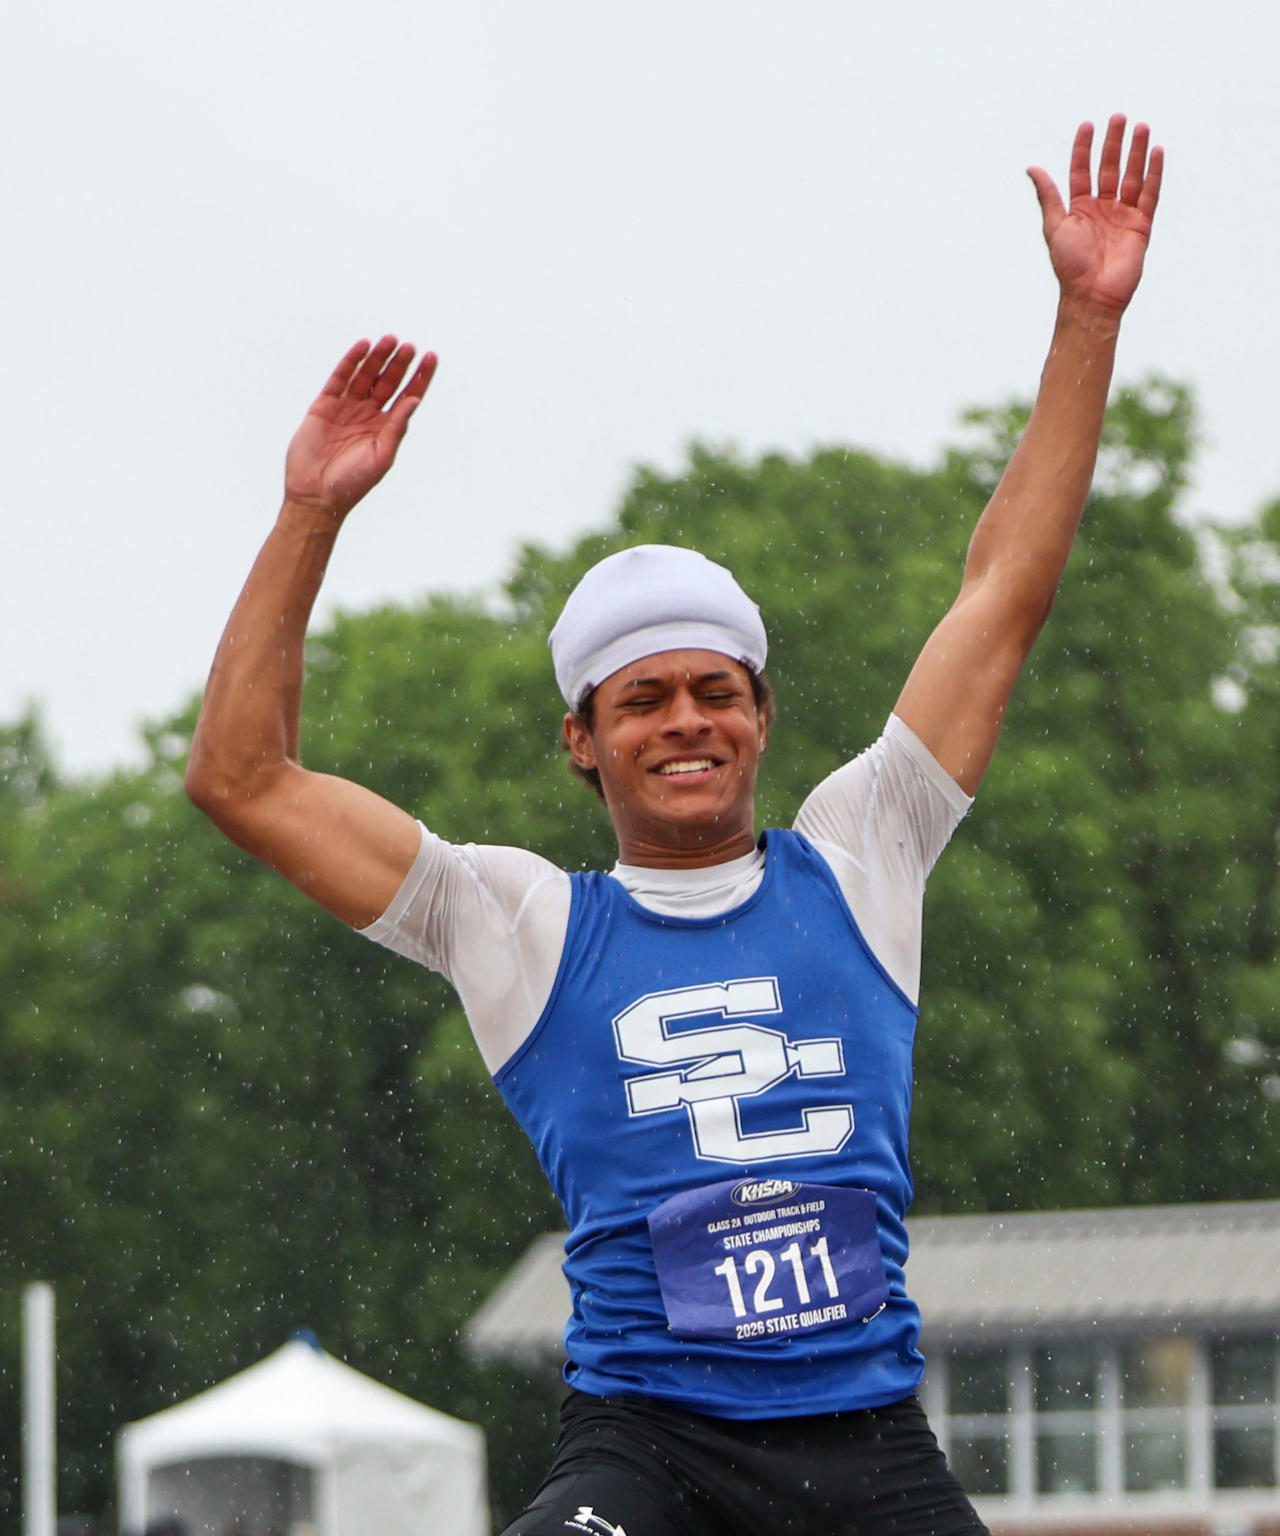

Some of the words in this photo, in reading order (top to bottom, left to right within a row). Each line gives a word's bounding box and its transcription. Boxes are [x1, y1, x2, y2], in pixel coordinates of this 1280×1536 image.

[612, 976, 855, 1165] SC
[740, 1179, 793, 1202] KHSAA
[707, 1220, 730, 1233] CLASS
[732, 1217, 742, 1229] 2A
[744, 1210, 776, 1226] OUTDOOR
[777, 1206, 800, 1219] TRACK
[806, 1200, 825, 1213] FIELD
[723, 1232, 752, 1250] STATE
[753, 1218, 821, 1244] CHAMPIONSHIPS
[714, 1237, 839, 1318] 1211
[736, 1322, 765, 1340] 2026
[766, 1315, 800, 1334] STATE
[800, 1303, 847, 1328] QUALIFIER
